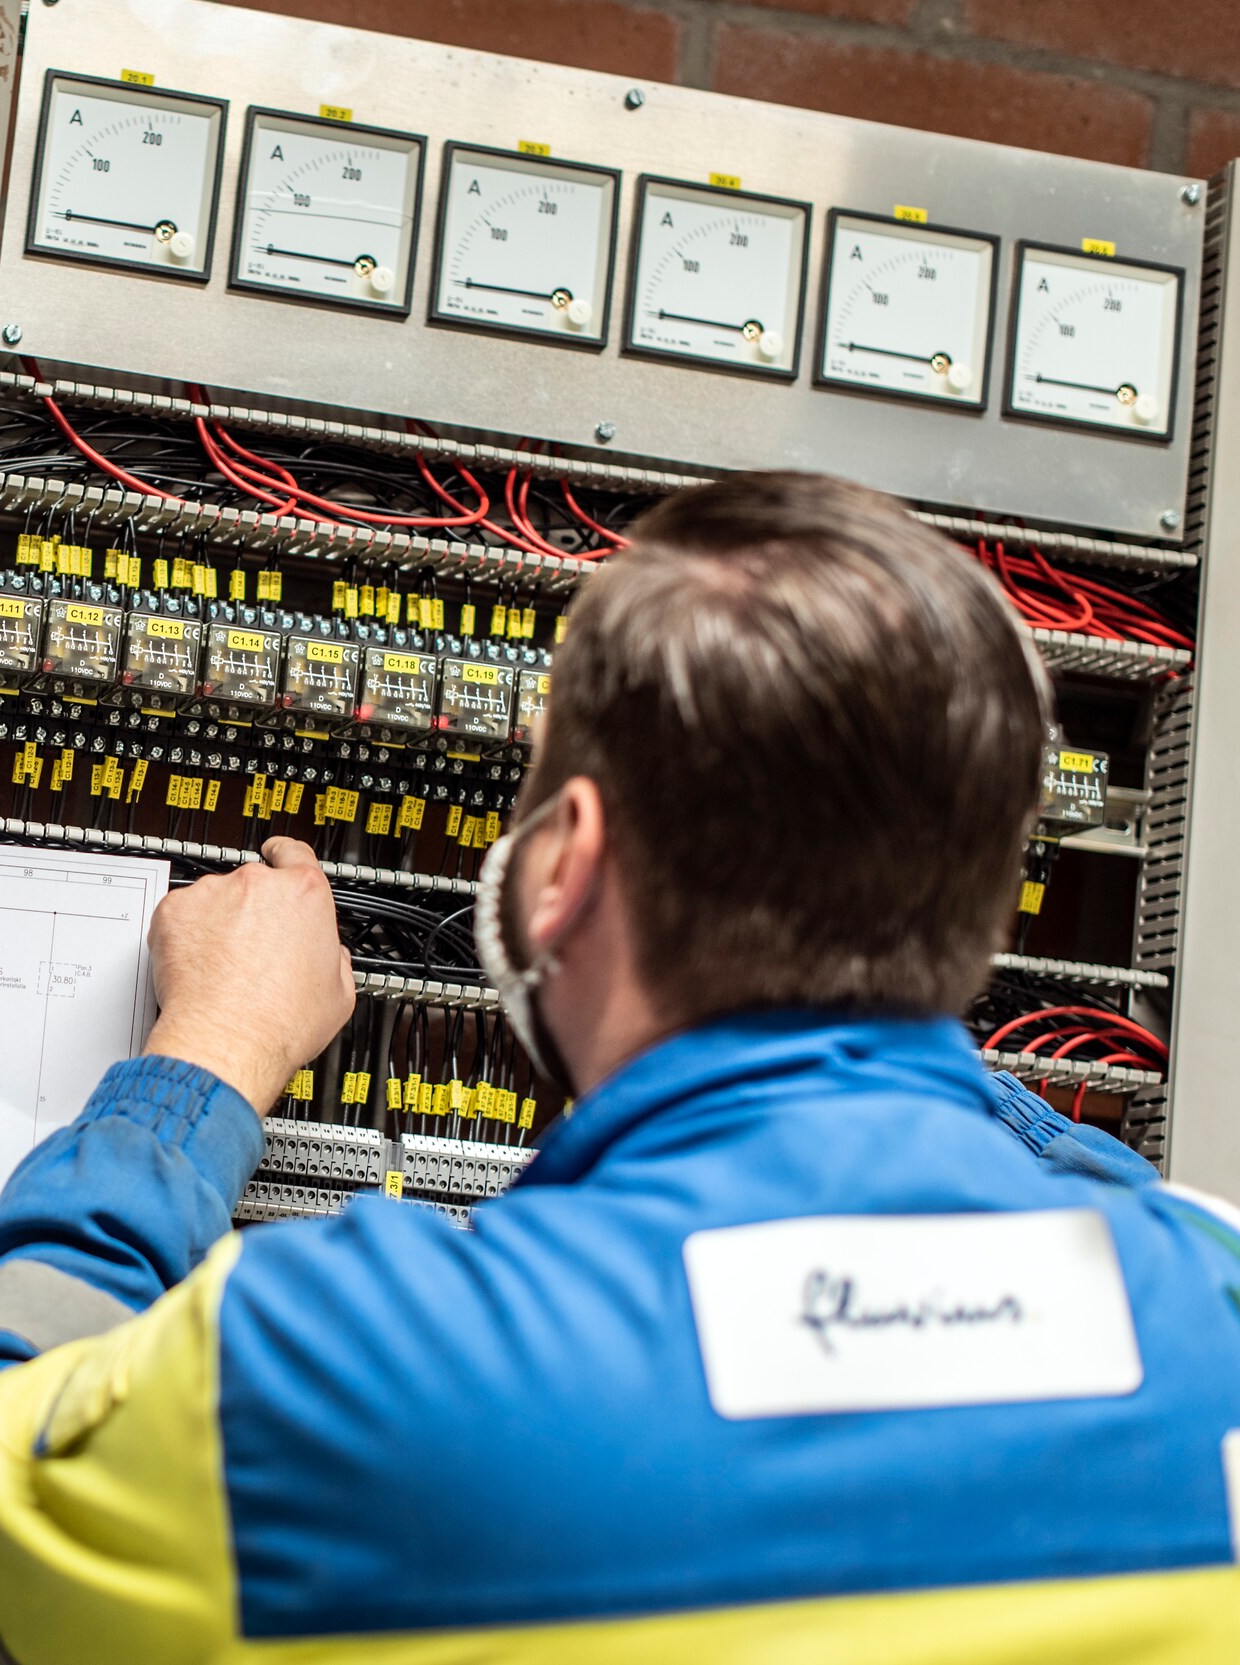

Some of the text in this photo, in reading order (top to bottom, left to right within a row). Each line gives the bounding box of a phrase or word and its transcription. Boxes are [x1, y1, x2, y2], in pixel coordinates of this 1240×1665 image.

[128, 73, 147, 83] 20.1
[70, 110, 83, 126] A
[326, 109, 346, 119] 20.2
[143, 132, 162, 145] 200
[271, 145, 284, 161] A
[93, 159, 110, 172] 100
[342, 167, 362, 181] 200
[468, 180, 481, 196] A
[294, 194, 310, 207] 100
[538, 201, 557, 215] 200
[661, 212, 673, 228] A
[491, 228, 508, 241] 100
[850, 246, 863, 261] A
[1037, 278, 1049, 293] A
[71, 610, 99, 621] C1.12
[152, 624, 179, 634] C1.13
[232, 636, 259, 647] C1.14
[312, 648, 339, 658] C1.15
[71, 666, 93, 675] 110VDC
[388, 659, 415, 669] C1.18
[467, 669, 493, 679] C1.19
[150, 680, 172, 688] 110VDC
[231, 690, 253, 698] 110VDC
[310, 702, 332, 710] 110VDC
[387, 714, 409, 722] 110VDC
[465, 724, 486, 732] 110VDC
[1064, 757, 1089, 768] C1.71
[107, 760, 116, 783] C1.13-3
[135, 761, 146, 787] C1.13-11
[113, 771, 121, 794] C1.13-5
[170, 778, 178, 801] C1.14-1
[255, 777, 263, 799] C1.15-3
[182, 781, 190, 804] C1.14-5
[209, 784, 217, 806] C1.14-9
[275, 784, 283, 807] C1.15-7
[328, 791, 336, 813] C1.18-3
[338, 792, 346, 815] C1.18-3
[348, 794, 356, 817] C1.18-7
[52, 975, 73, 984] 30.80
[347, 1076, 355, 1102] 87.2/1-16
[359, 1074, 368, 1100] 87.2/1-17
[390, 1175, 398, 1200] 7.3/1
